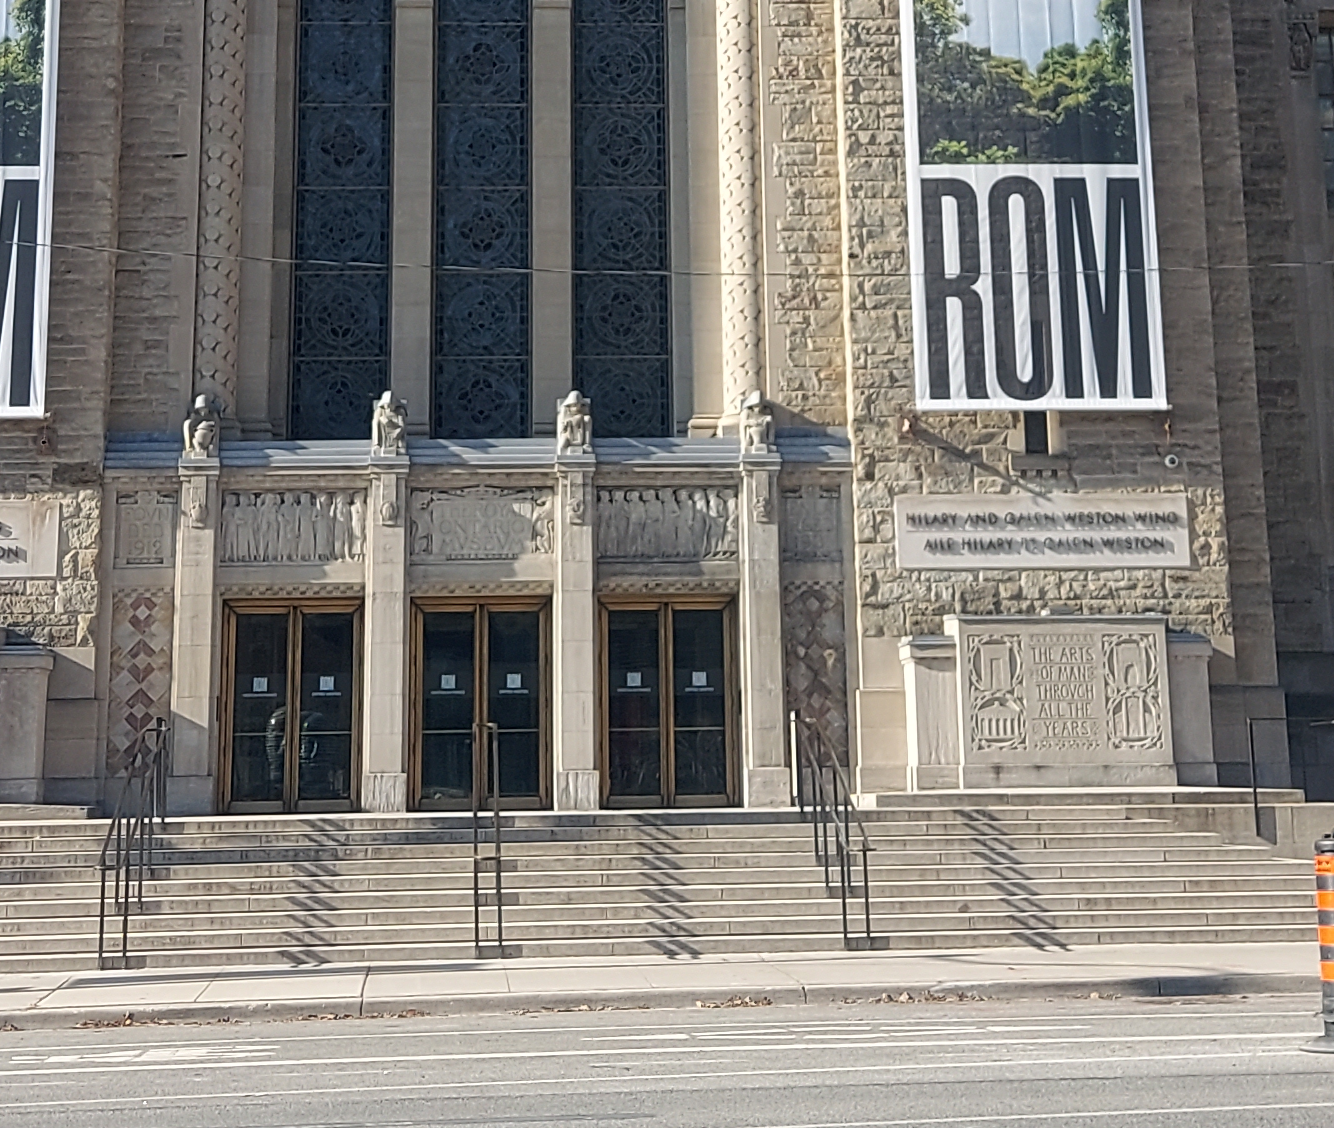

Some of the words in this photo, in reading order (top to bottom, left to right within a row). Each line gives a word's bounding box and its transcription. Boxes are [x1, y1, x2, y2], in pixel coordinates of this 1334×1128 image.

[920, 175, 1153, 401] ROM
[965, 512, 998, 524] AND
[1064, 511, 1127, 524] WESTON
[439, 519, 525, 535] ONTARIO
[1100, 536, 1165, 549] WESTON
[1031, 647, 1054, 663] THE
[1060, 647, 1094, 662] ARTS
[1040, 666, 1054, 681] OF
[1058, 666, 1086, 681] MAN
[1039, 702, 1067, 718] ALL
[1067, 702, 1092, 718] THE
[1043, 721, 1090, 737] YEARS
